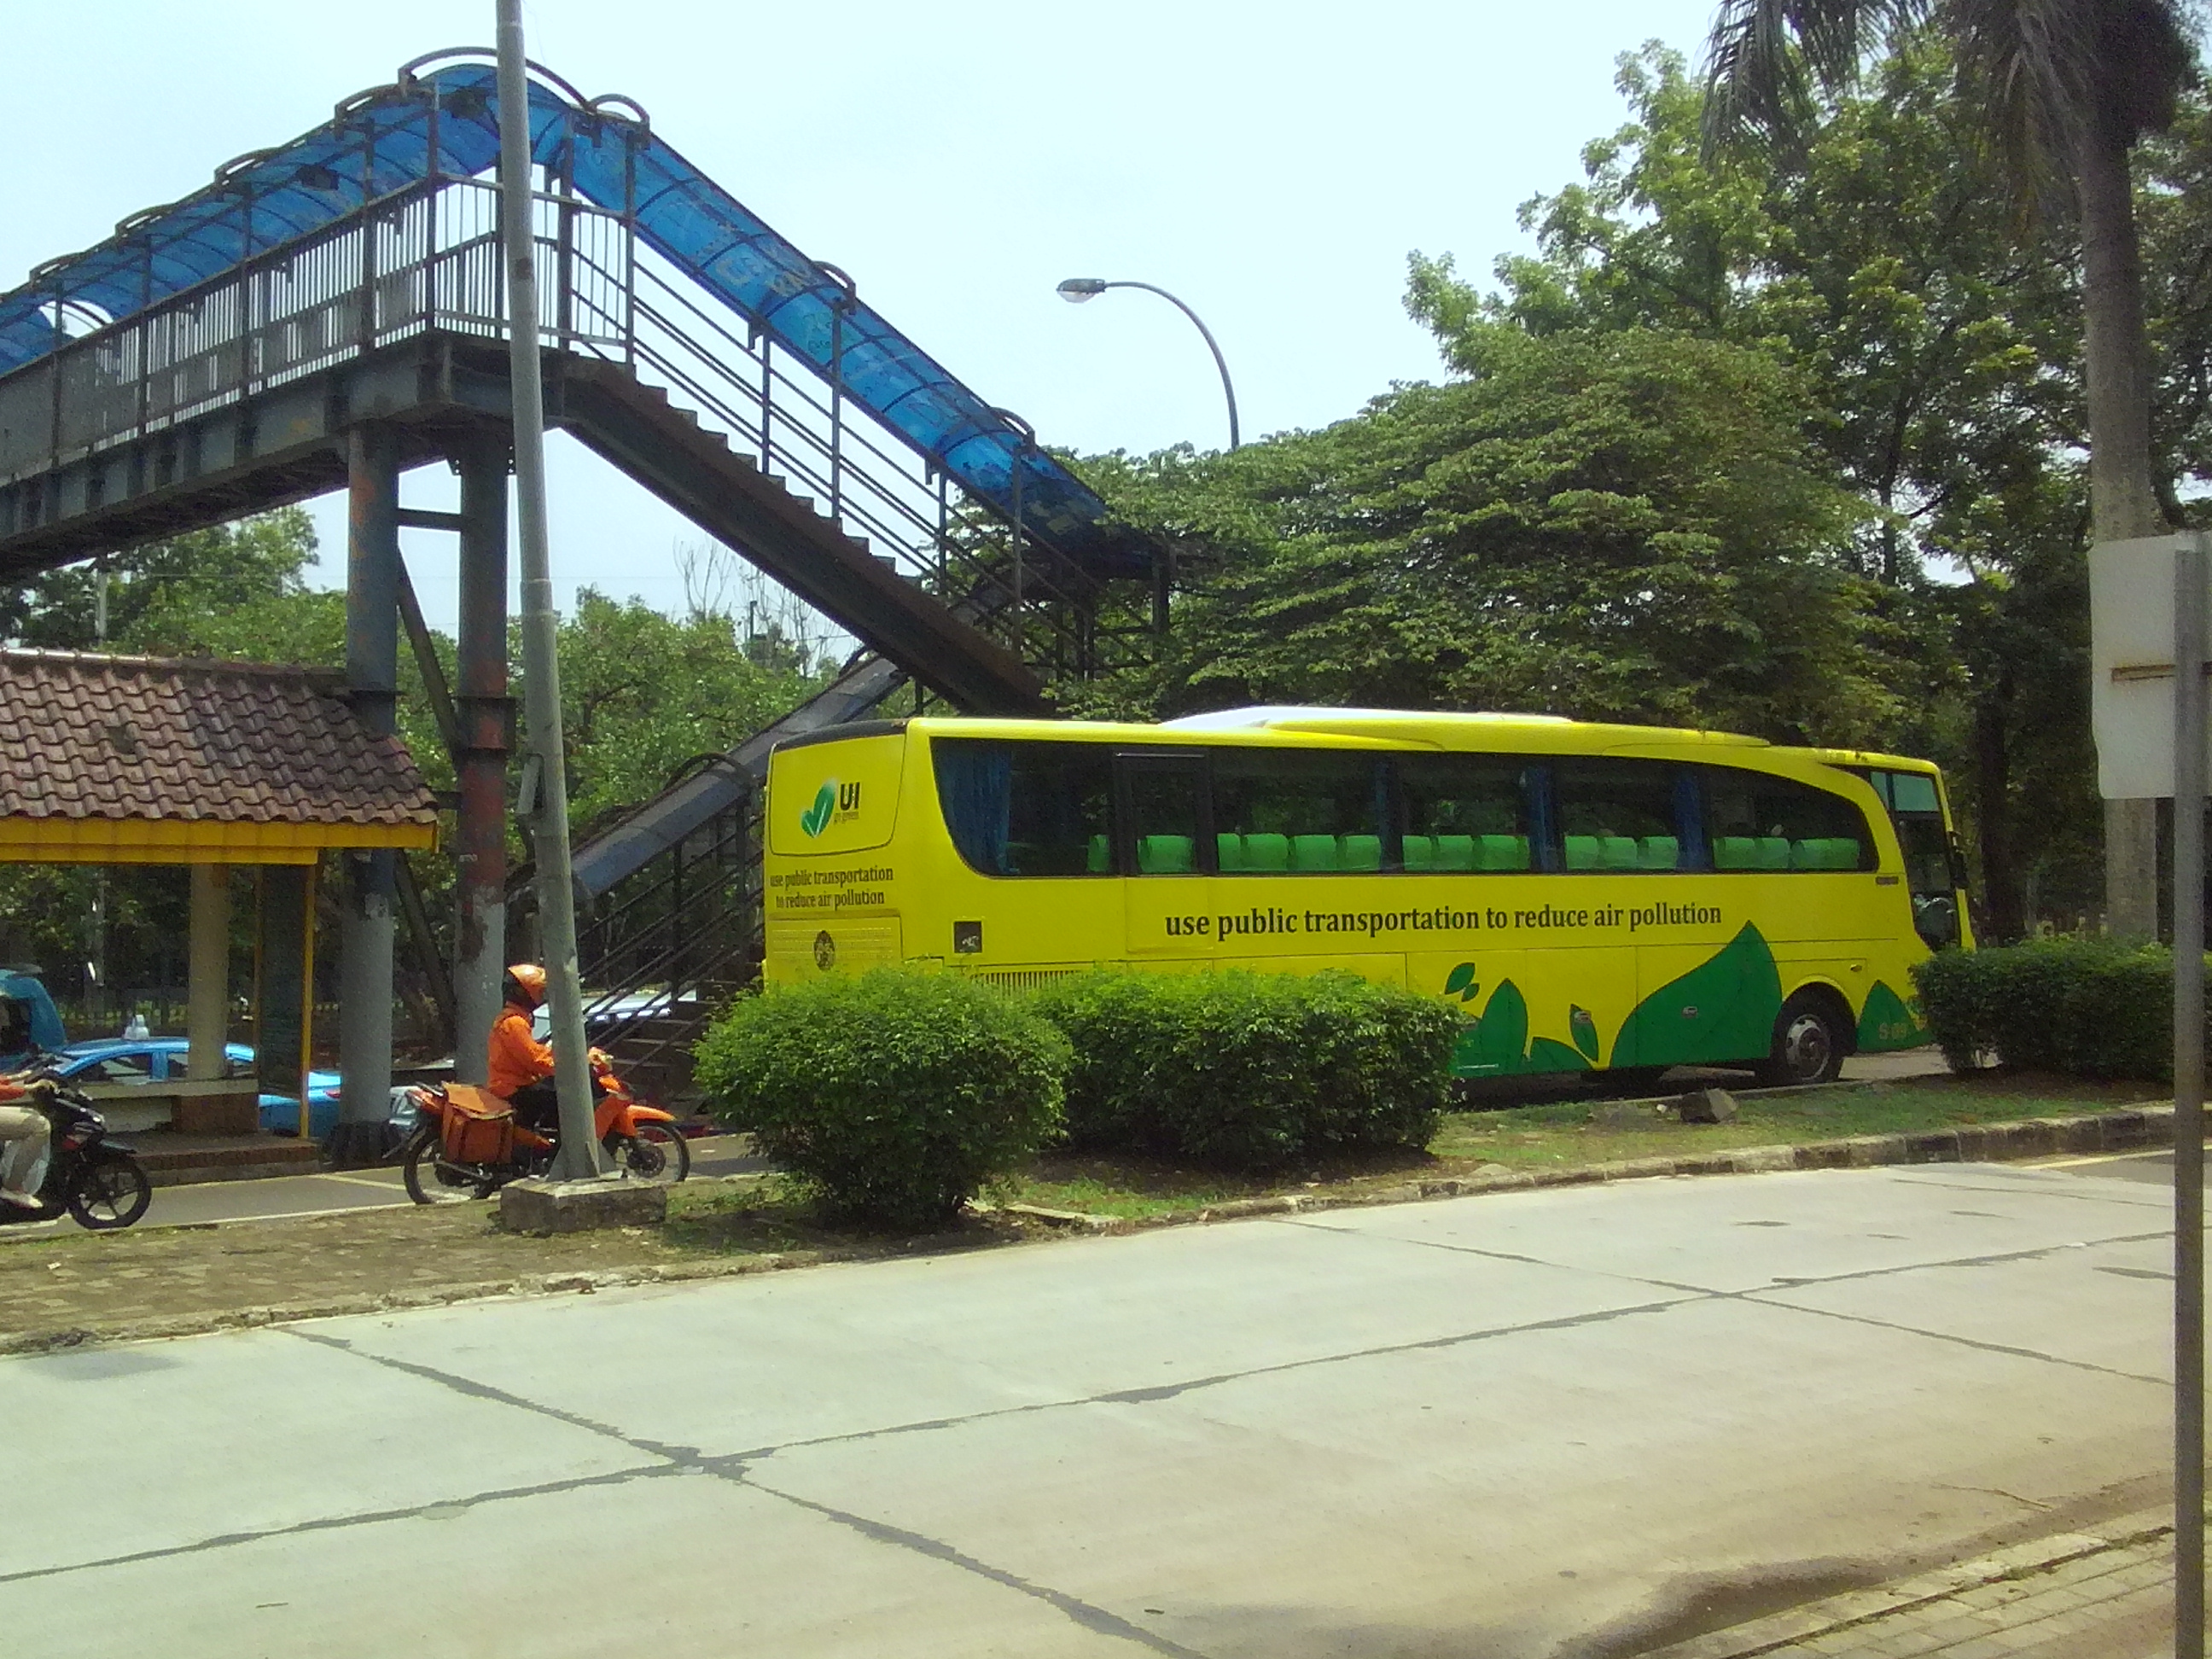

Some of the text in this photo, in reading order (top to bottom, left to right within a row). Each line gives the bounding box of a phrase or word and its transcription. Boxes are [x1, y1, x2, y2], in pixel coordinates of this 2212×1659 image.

[841, 782, 860, 811] UI
[785, 870, 812, 891] public
[813, 864, 894, 888] transportation
[786, 892, 816, 908] reduce
[818, 890, 832, 907] air
[834, 888, 885, 911] pollution
[1166, 902, 1722, 942] use public transportation to reduce air pollution
